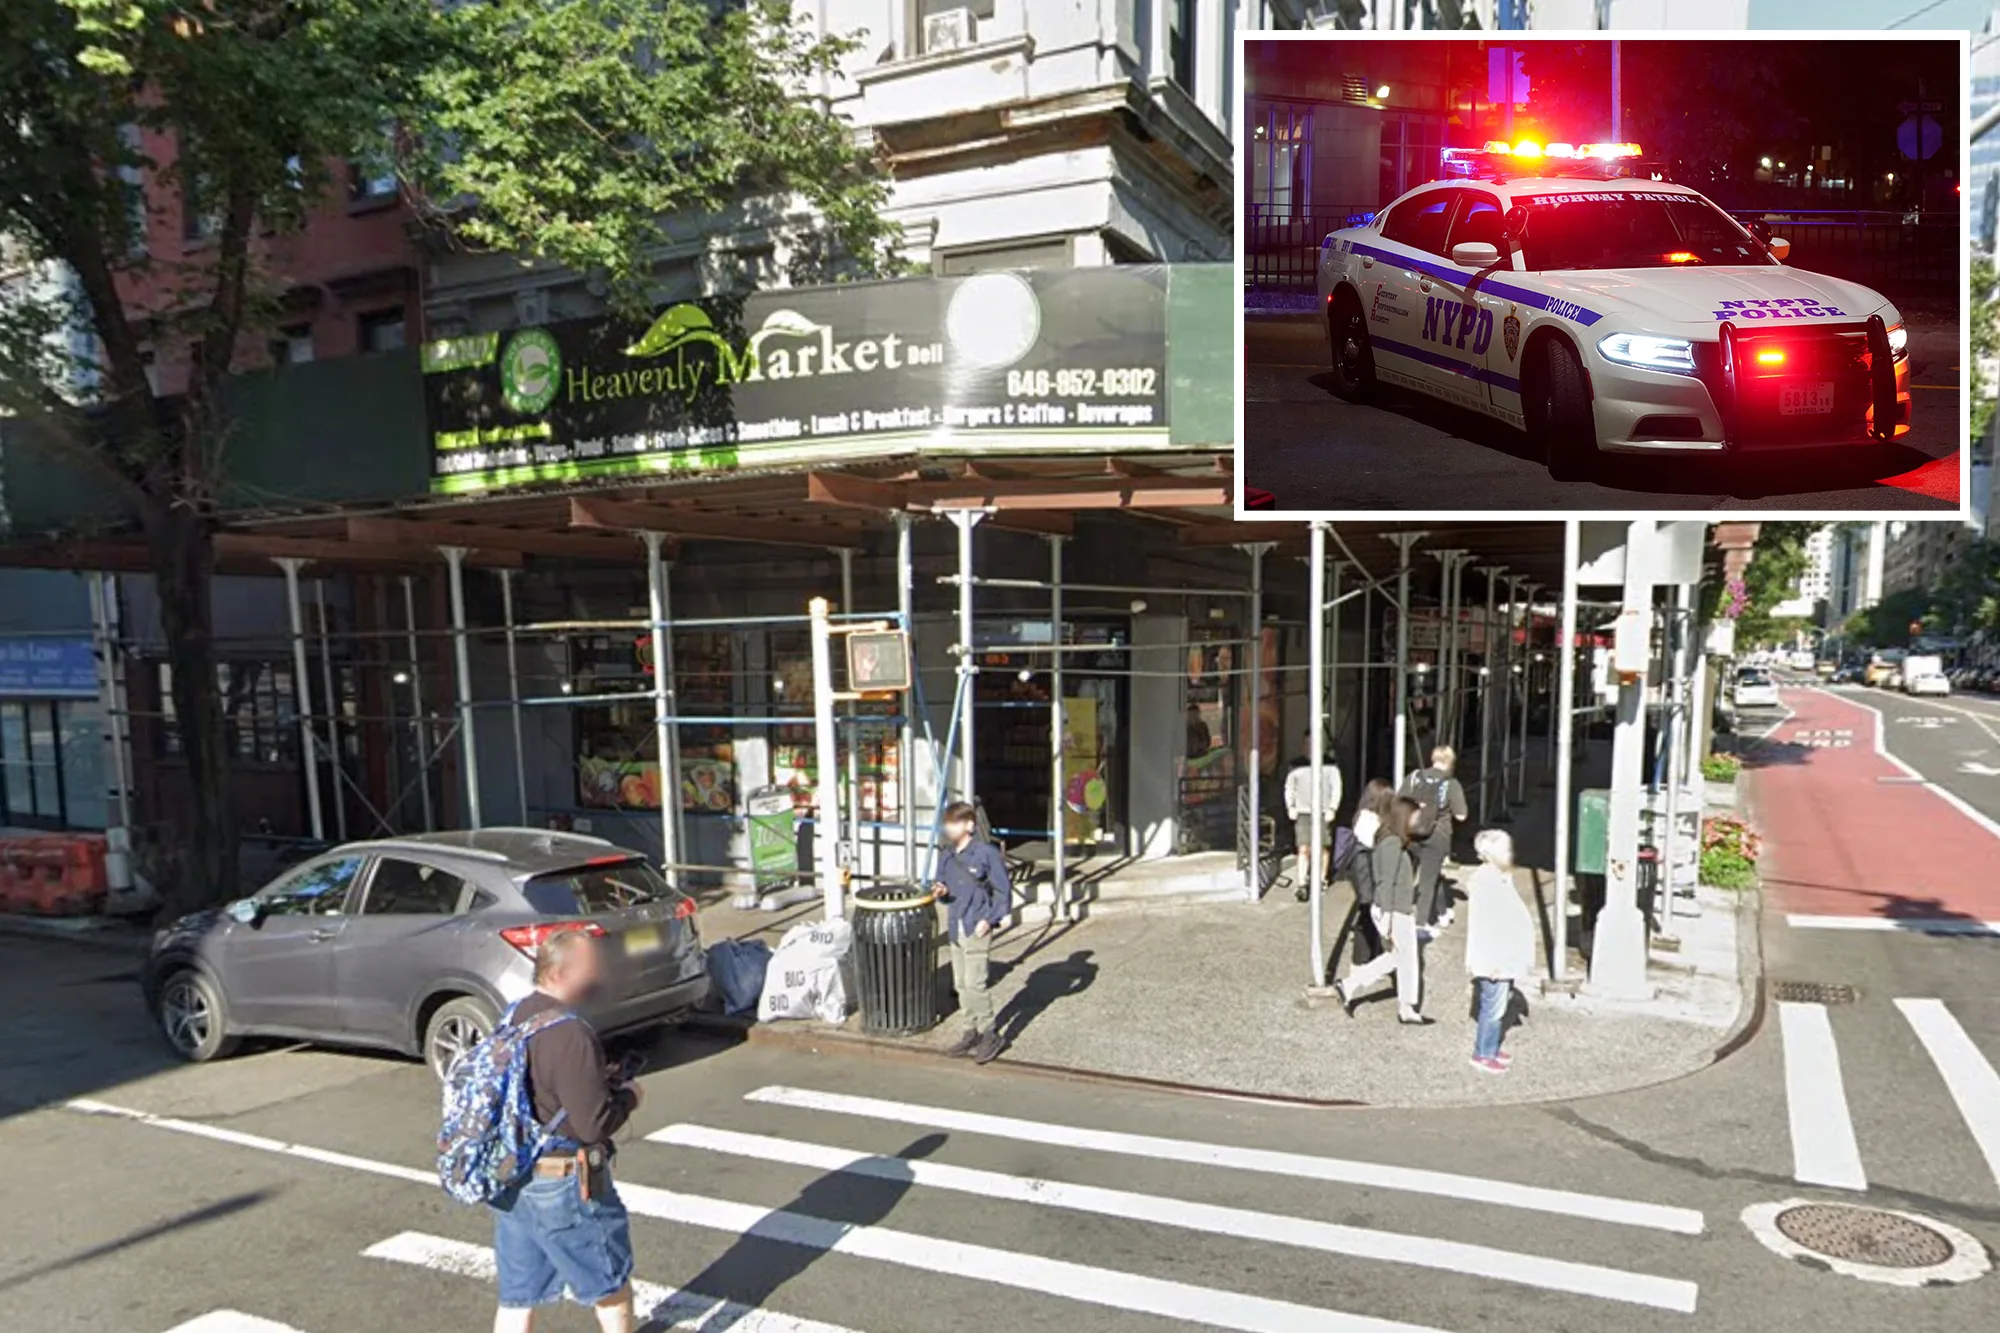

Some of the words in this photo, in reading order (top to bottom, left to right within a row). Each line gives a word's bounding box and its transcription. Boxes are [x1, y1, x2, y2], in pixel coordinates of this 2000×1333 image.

[1532, 193, 1625, 206] HIGHWAY
[1630, 192, 1697, 204] PATROL
[1545, 296, 1581, 321] POLICE
[1719, 298, 1820, 310] NYPD
[1712, 307, 1847, 321] POLICE
[1422, 296, 1494, 356] NYPD
[566, 346, 705, 403] Heavenly
[715, 325, 903, 385] Market
[1784, 390, 1818, 407] 5813
